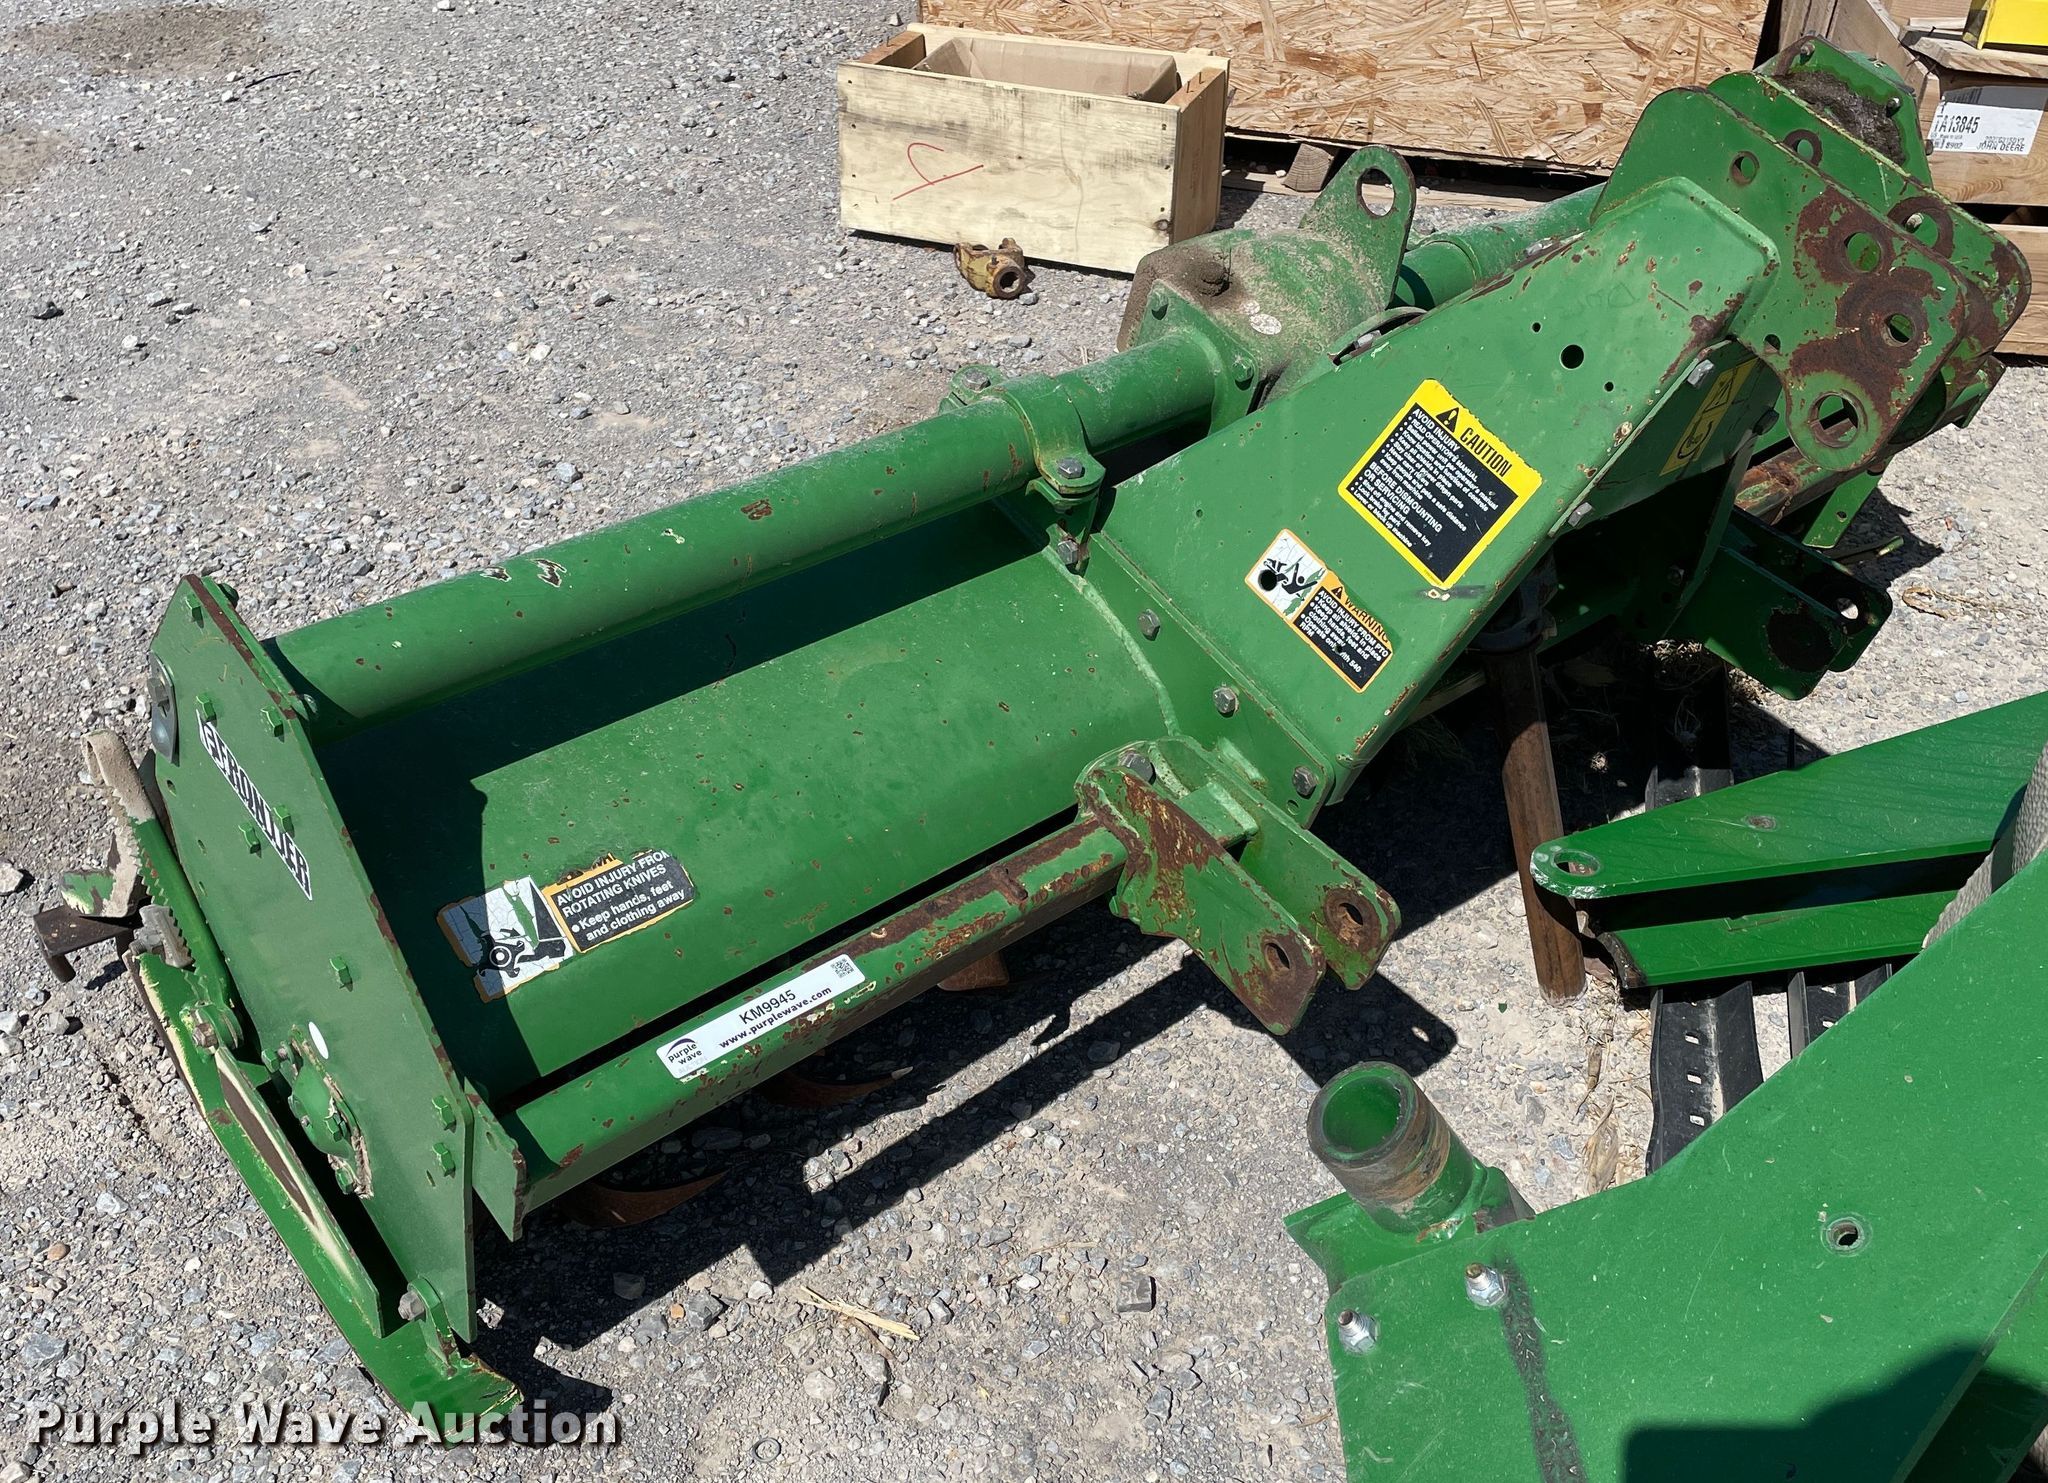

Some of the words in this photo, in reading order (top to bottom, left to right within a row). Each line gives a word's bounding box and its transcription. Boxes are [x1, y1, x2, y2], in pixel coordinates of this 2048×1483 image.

[1934, 115, 1980, 133] TA13845
[1977, 140, 1998, 151] JOHN
[2000, 143, 2025, 152] DEERE
[1411, 419, 1427, 434] READ
[1455, 460, 1479, 482] MANUAL
[1413, 408, 1435, 430] AVOID
[1433, 427, 1460, 453] INJURY
[1459, 427, 1513, 477] CAUTION
[1379, 458, 1392, 472] away
[1391, 469, 1404, 482] from
[1403, 479, 1424, 500] machine
[1388, 447, 1404, 462] Never
[1401, 460, 1415, 474] carry
[1392, 441, 1405, 454] Stay
[1403, 451, 1417, 465] clear
[1415, 462, 1422, 470] of
[1420, 468, 1437, 484] power
[1435, 481, 1452, 497] driven
[1449, 495, 1464, 510] parts
[1397, 436, 1411, 450] Keep
[1409, 447, 1418, 455] all
[1416, 453, 1434, 471] shields
[1437, 473, 1453, 489] place
[1402, 430, 1417, 445] Know
[1415, 442, 1435, 462] location
[1433, 459, 1445, 471] and
[1443, 468, 1464, 489] function
[1462, 486, 1470, 494] of
[1467, 491, 1489, 512] controls
[1421, 439, 1438, 456] power
[1437, 452, 1449, 465] unit
[1446, 462, 1456, 473] per
[1454, 469, 1480, 495] operator's
[1478, 491, 1498, 510] manual
[1358, 484, 1371, 497] Lock
[1369, 495, 1384, 510] brake
[1388, 514, 1402, 528] park
[1362, 479, 1374, 492] Shut
[1373, 489, 1381, 498] off
[1379, 496, 1396, 513] engine
[1395, 510, 1406, 522] and
[1404, 520, 1422, 538] remove
[1420, 535, 1432, 548] key
[1363, 469, 1376, 482] OR
[1374, 478, 1411, 515] SERVICING
[1369, 461, 1397, 489] BEFORE
[1395, 486, 1443, 533] DISMOUNTING
[1383, 452, 1398, 467] Keep
[1395, 463, 1413, 482] people
[1412, 478, 1423, 490] and
[1420, 487, 1433, 500] pets
[1435, 501, 1447, 513] safe
[1446, 510, 1467, 531] distance
[1354, 490, 1369, 506] Lower
[1373, 508, 1387, 523] block
[1384, 521, 1393, 530] up
[1392, 527, 1413, 548] machine
[1299, 621, 1315, 637] RPM
[1303, 616, 1327, 640] Operate
[1349, 659, 1362, 673] 540
[1308, 610, 1332, 635] clothing
[1312, 604, 1329, 622] Keep
[1327, 618, 1348, 639] hands,
[1345, 636, 1359, 649] feet
[1357, 646, 1370, 660] and
[1317, 599, 1334, 616] Keep
[1332, 612, 1341, 622] all
[1339, 619, 1361, 641] shields
[1359, 638, 1367, 647] in
[1364, 644, 1382, 663] place
[1318, 589, 1338, 610] AVOID
[1336, 606, 1359, 630] INJURY
[1357, 626, 1376, 646] FROM
[1374, 643, 1389, 658] PTO
[1345, 597, 1389, 643] WARNING
[554, 882, 595, 906] AVOID
[593, 863, 638, 888] INJURY
[561, 883, 624, 917] ROTATING
[623, 863, 666, 890] KNIVES
[578, 908, 612, 932] Keep
[610, 889, 651, 918] hands,
[650, 879, 674, 898] feet
[585, 924, 609, 942] and
[609, 900, 657, 934] clothing
[657, 888, 685, 912] away
[718, 985, 833, 1050] www.purplewave.com
[738, 989, 797, 1025] KM9945
[667, 1042, 698, 1062] purple
[677, 1049, 703, 1066] wave
